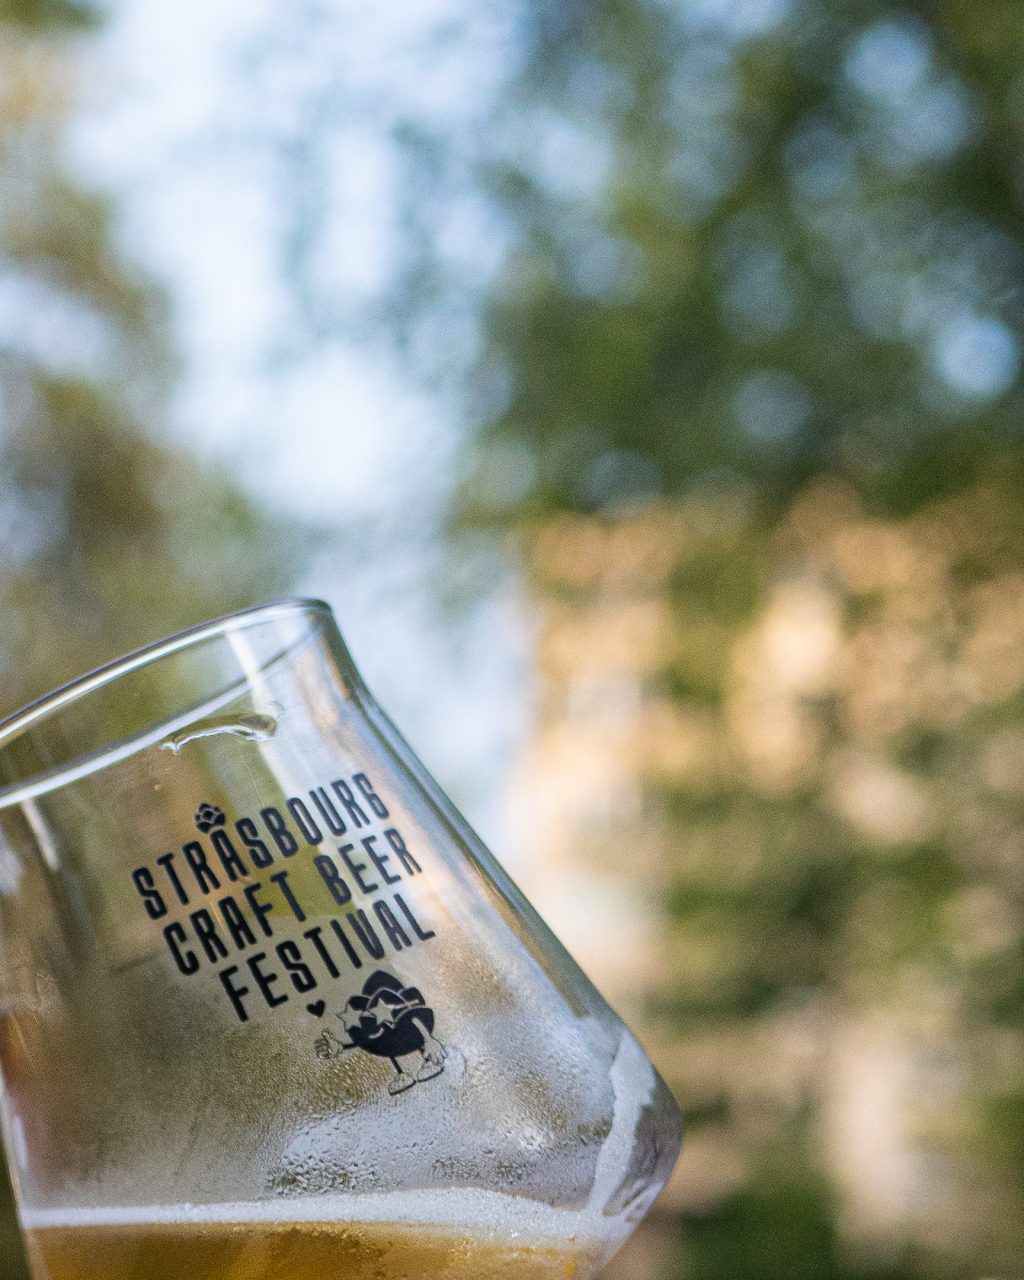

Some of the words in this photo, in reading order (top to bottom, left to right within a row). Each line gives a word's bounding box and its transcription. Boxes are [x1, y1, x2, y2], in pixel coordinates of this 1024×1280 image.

[131, 773, 389, 920] STRASBOURG
[163, 871, 306, 975] CRAFT
[314, 828, 422, 905] BEER
[219, 893, 435, 1022] FESTIVAL
